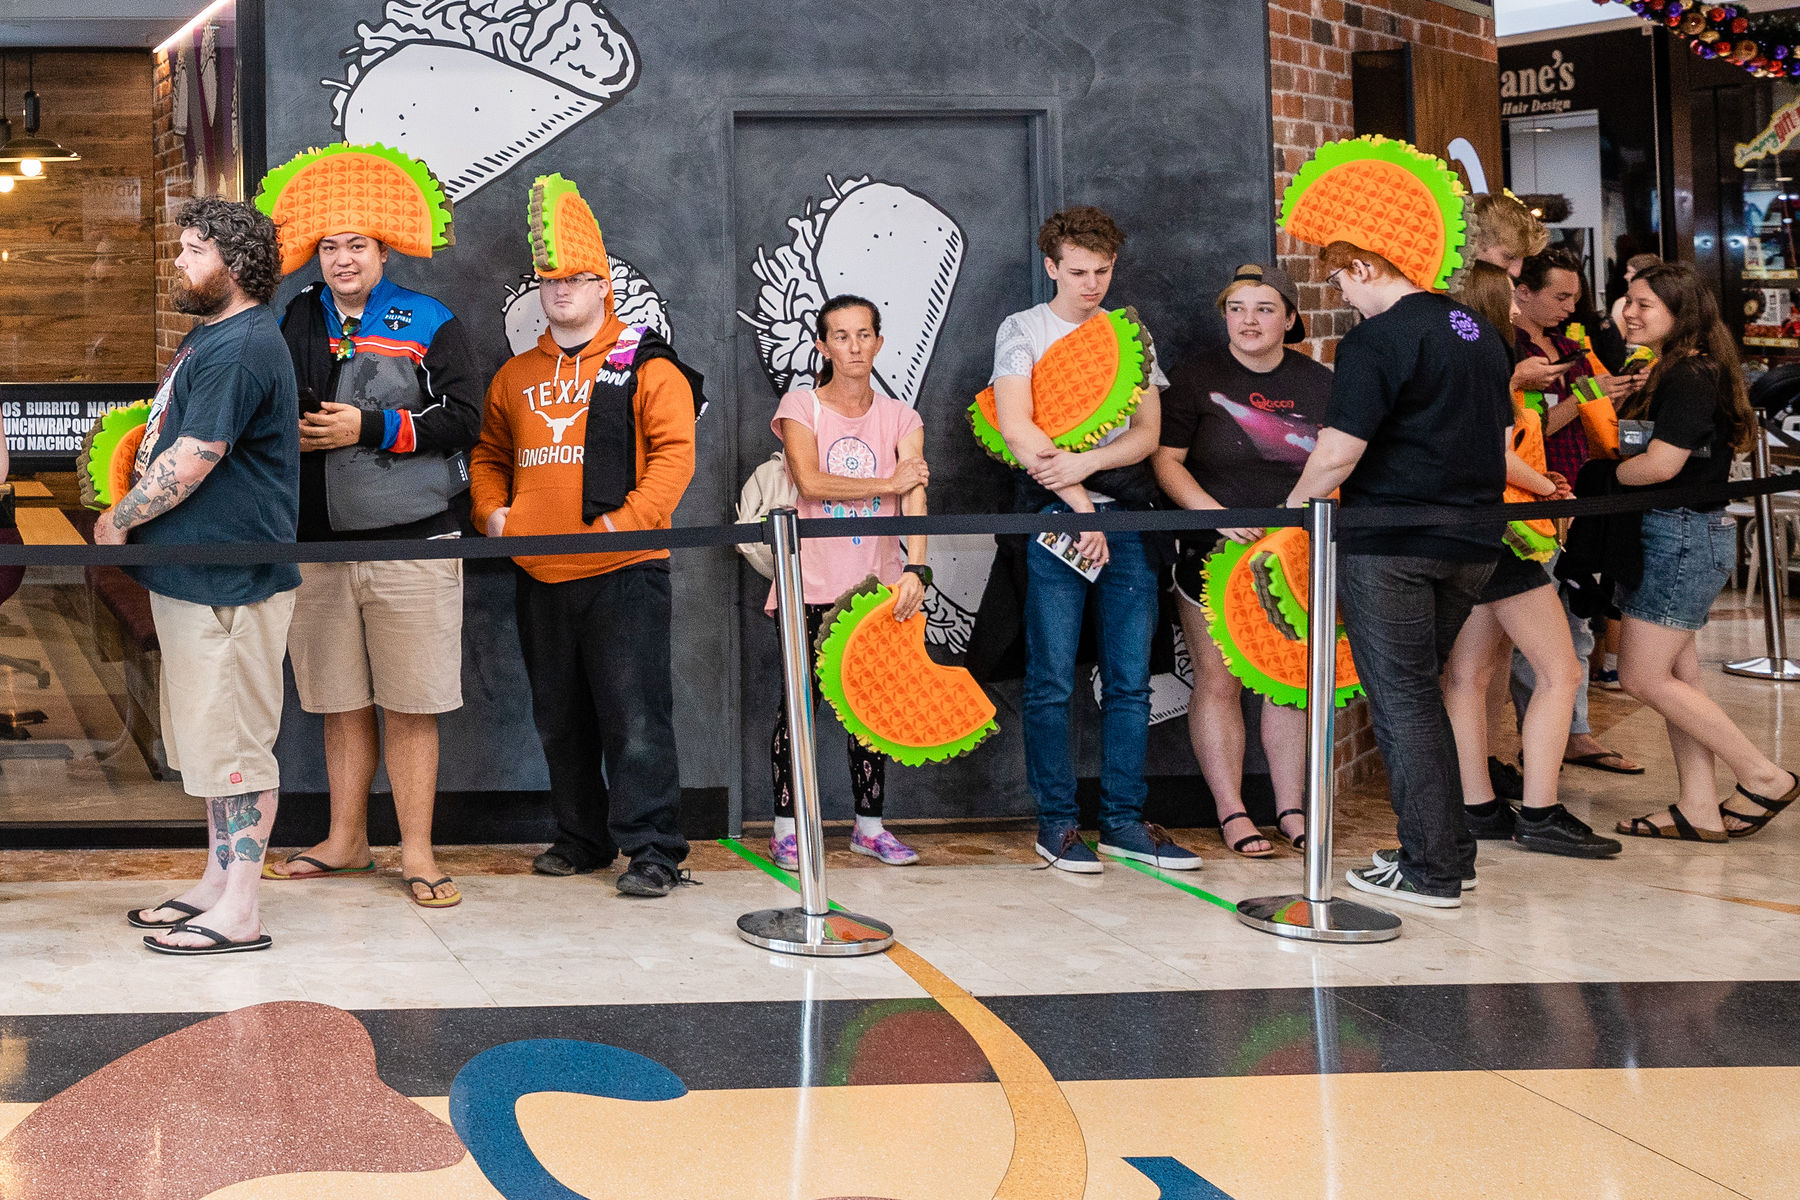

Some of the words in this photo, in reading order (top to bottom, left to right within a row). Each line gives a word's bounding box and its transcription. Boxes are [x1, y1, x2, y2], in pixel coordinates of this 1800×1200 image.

[1502, 102, 1529, 115] Hair
[1531, 99, 1571, 114] Design
[522, 379, 591, 411] TEXA
[26, 401, 80, 416] BURRITO
[27, 435, 84, 451] NACHOS
